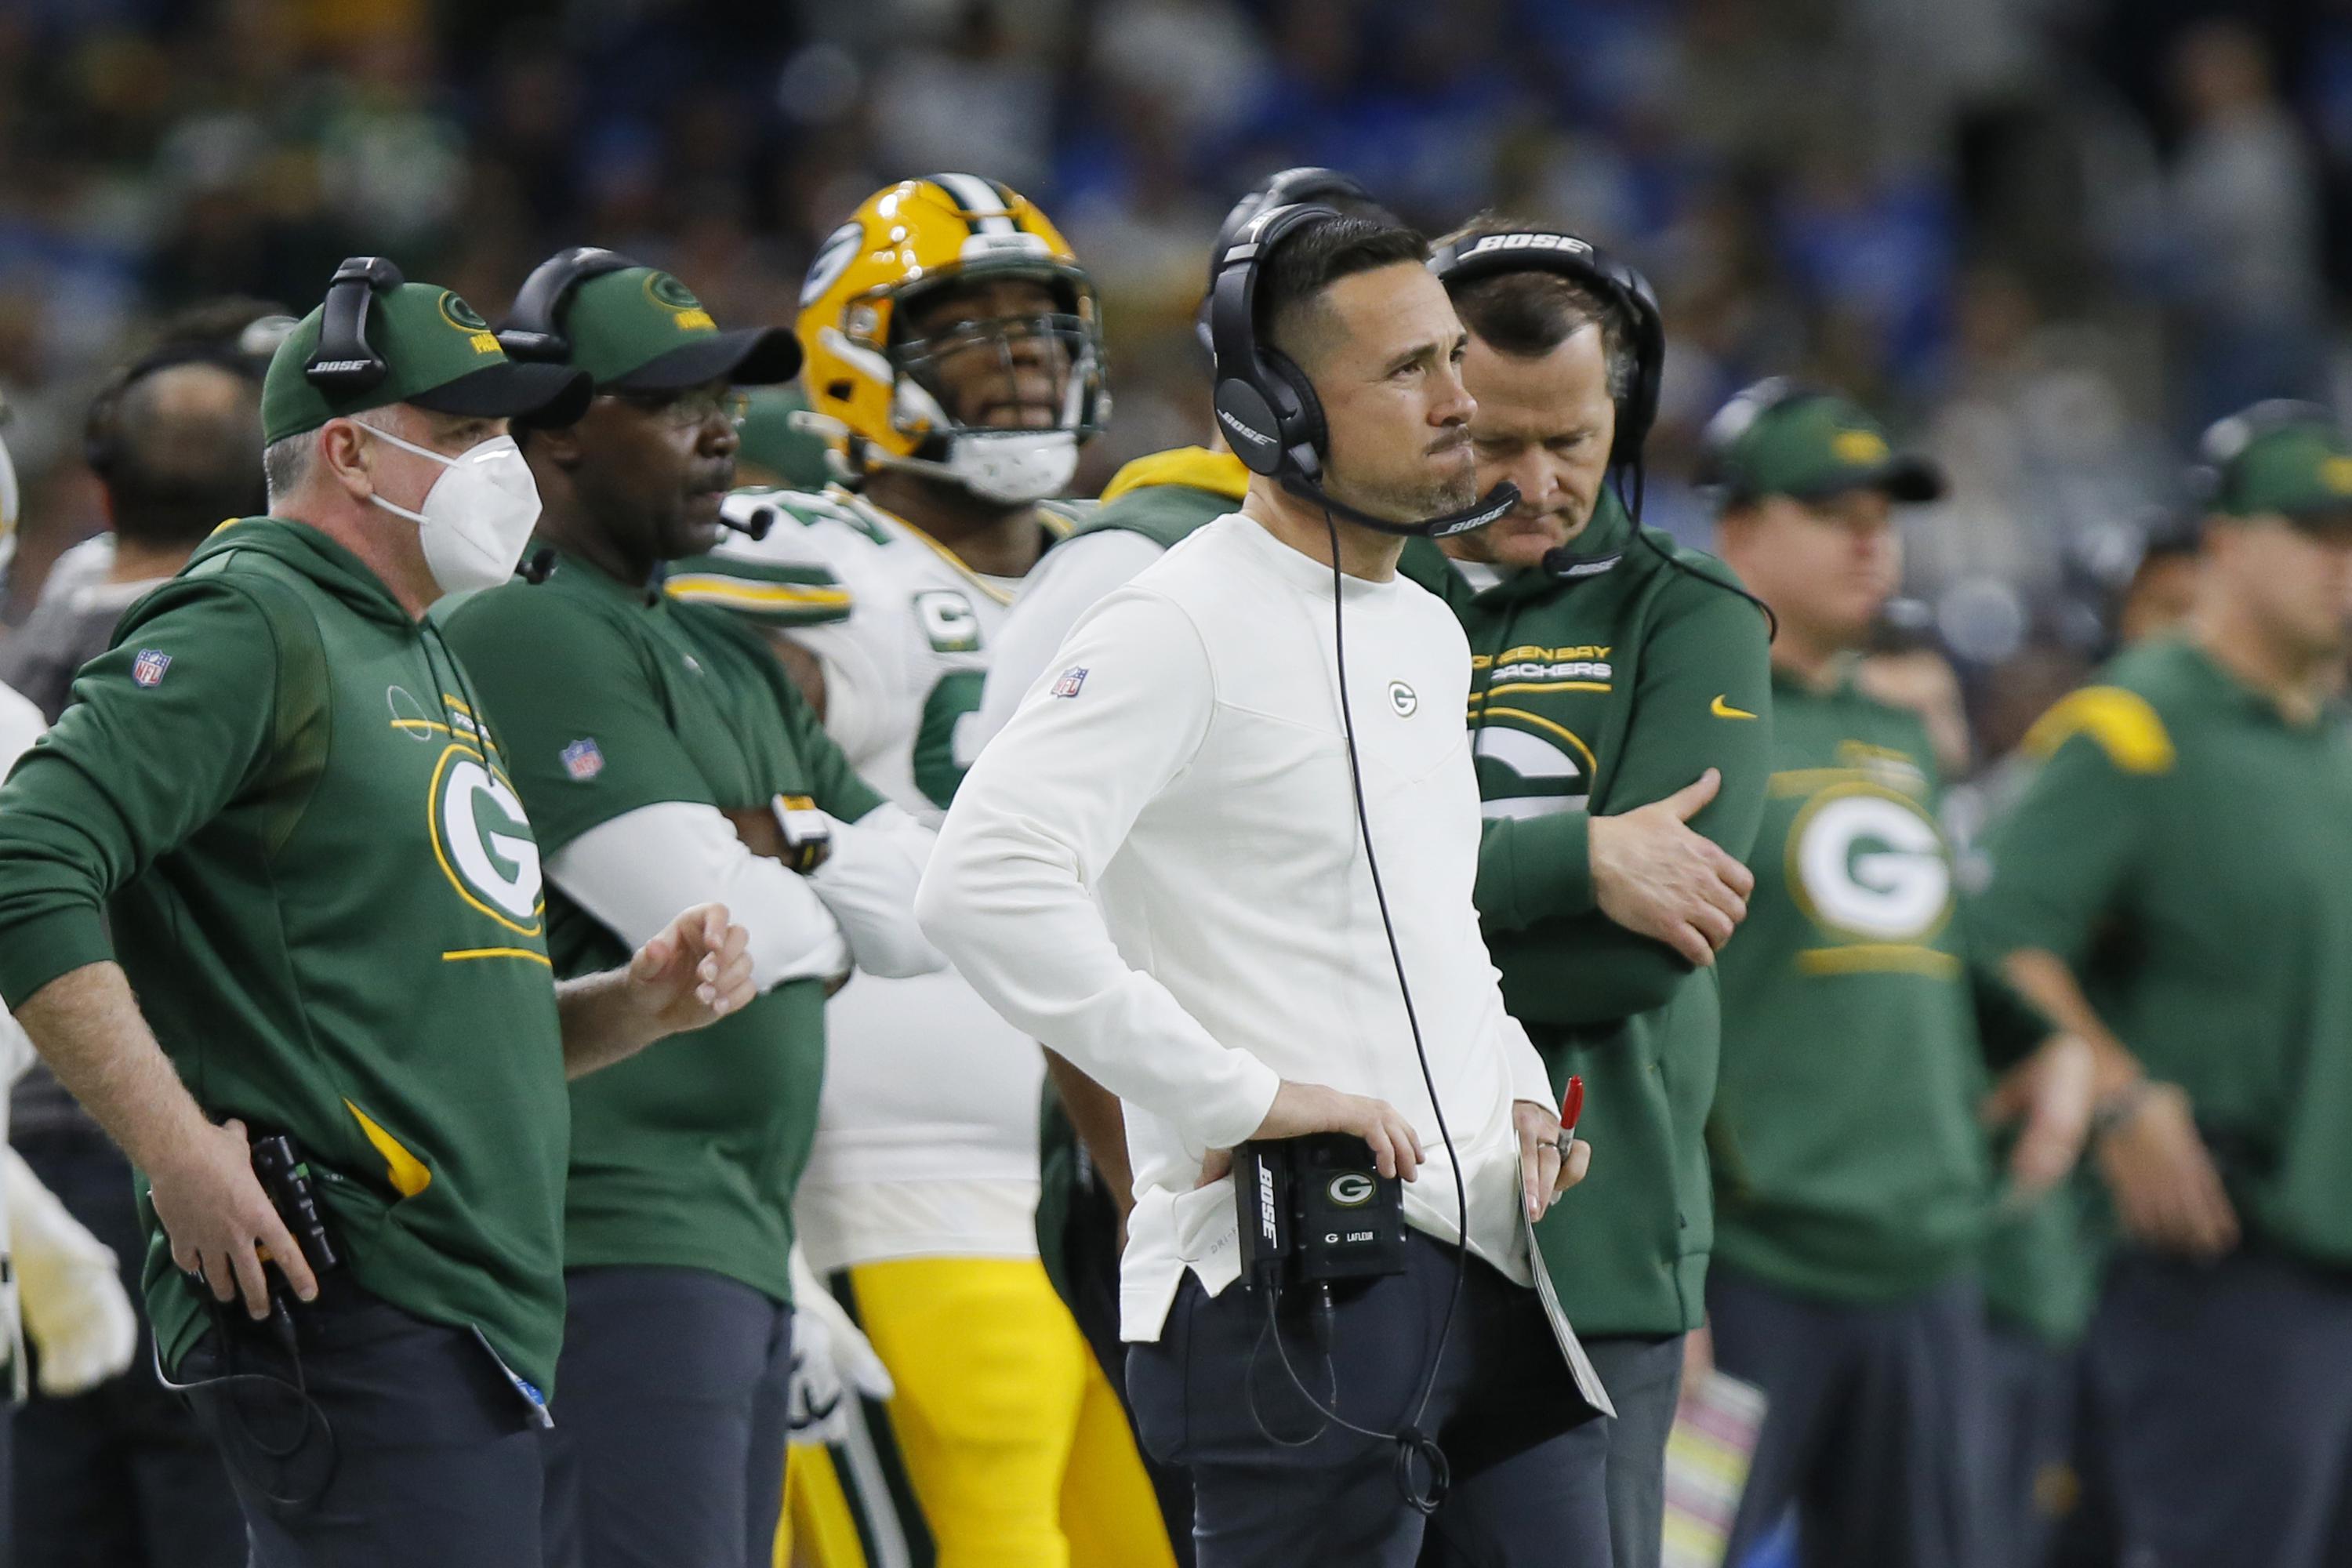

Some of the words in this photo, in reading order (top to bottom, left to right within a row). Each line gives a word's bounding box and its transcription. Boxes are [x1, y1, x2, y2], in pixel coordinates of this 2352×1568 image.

[1457, 233, 1593, 260] BOSE
[307, 360, 372, 372] BOSE
[1217, 408, 1277, 445] BOSE
[1434, 499, 1513, 536] BOSE
[1555, 645, 1612, 659] BAY
[136, 662, 162, 682] NFL
[1388, 682, 1417, 716] G
[442, 759, 543, 918] G
[1795, 795, 1951, 940] G
[1258, 1154, 1277, 1249] BOSE
[1330, 1174, 1373, 1203] G
[1325, 1233, 1339, 1243] G
